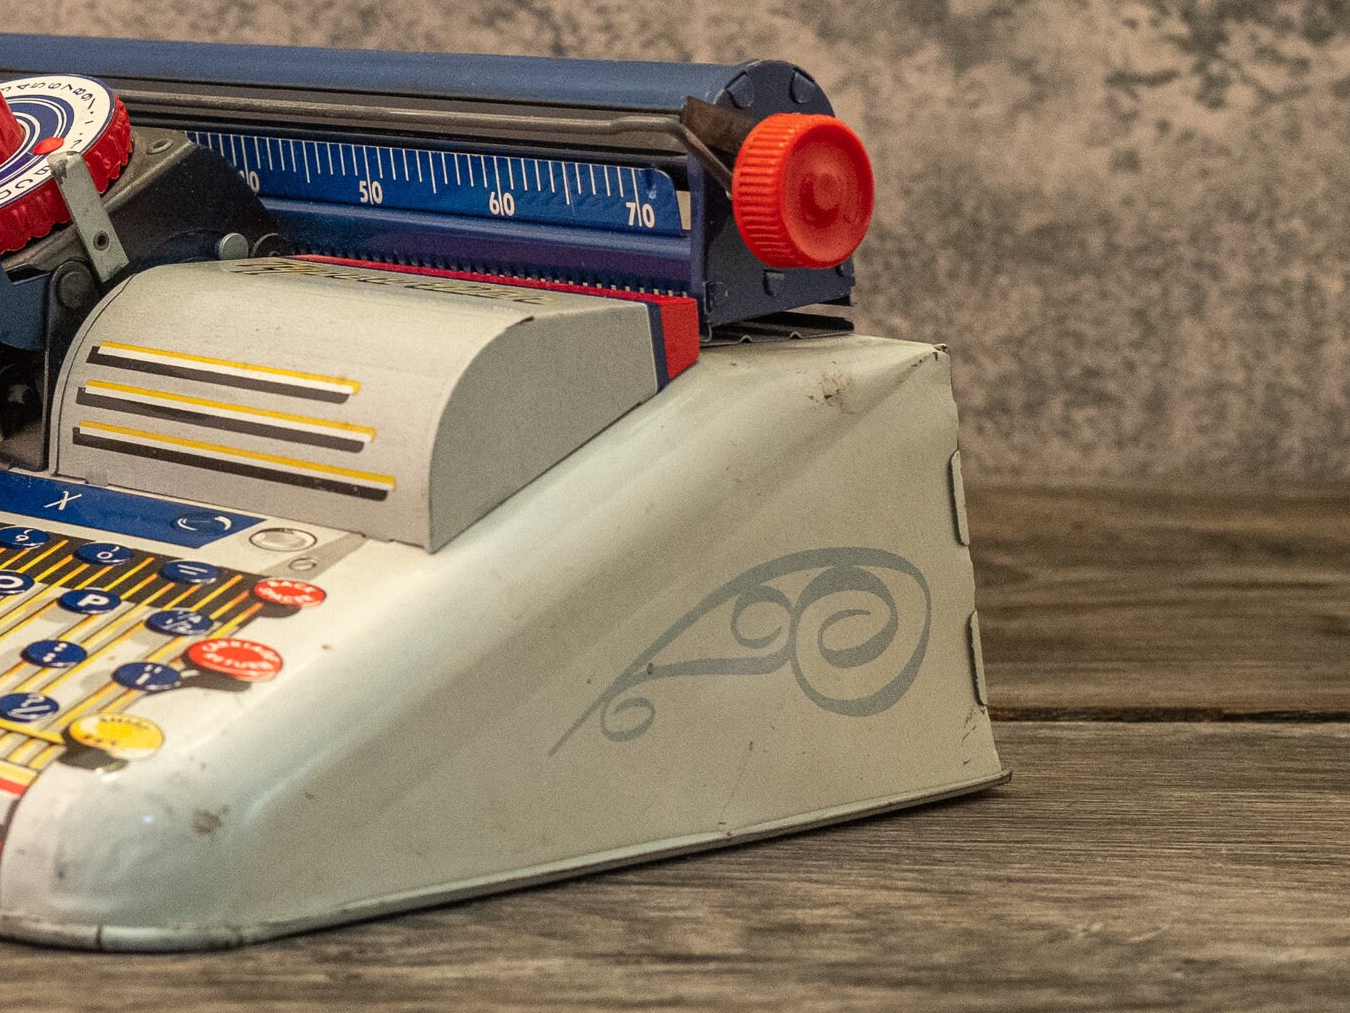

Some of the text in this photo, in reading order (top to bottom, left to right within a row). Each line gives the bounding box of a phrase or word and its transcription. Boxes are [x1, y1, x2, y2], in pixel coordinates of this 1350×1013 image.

[358, 180, 384, 205] 50
[488, 191, 516, 217] 60
[625, 201, 656, 229] 70
[76, 593, 111, 608] P
